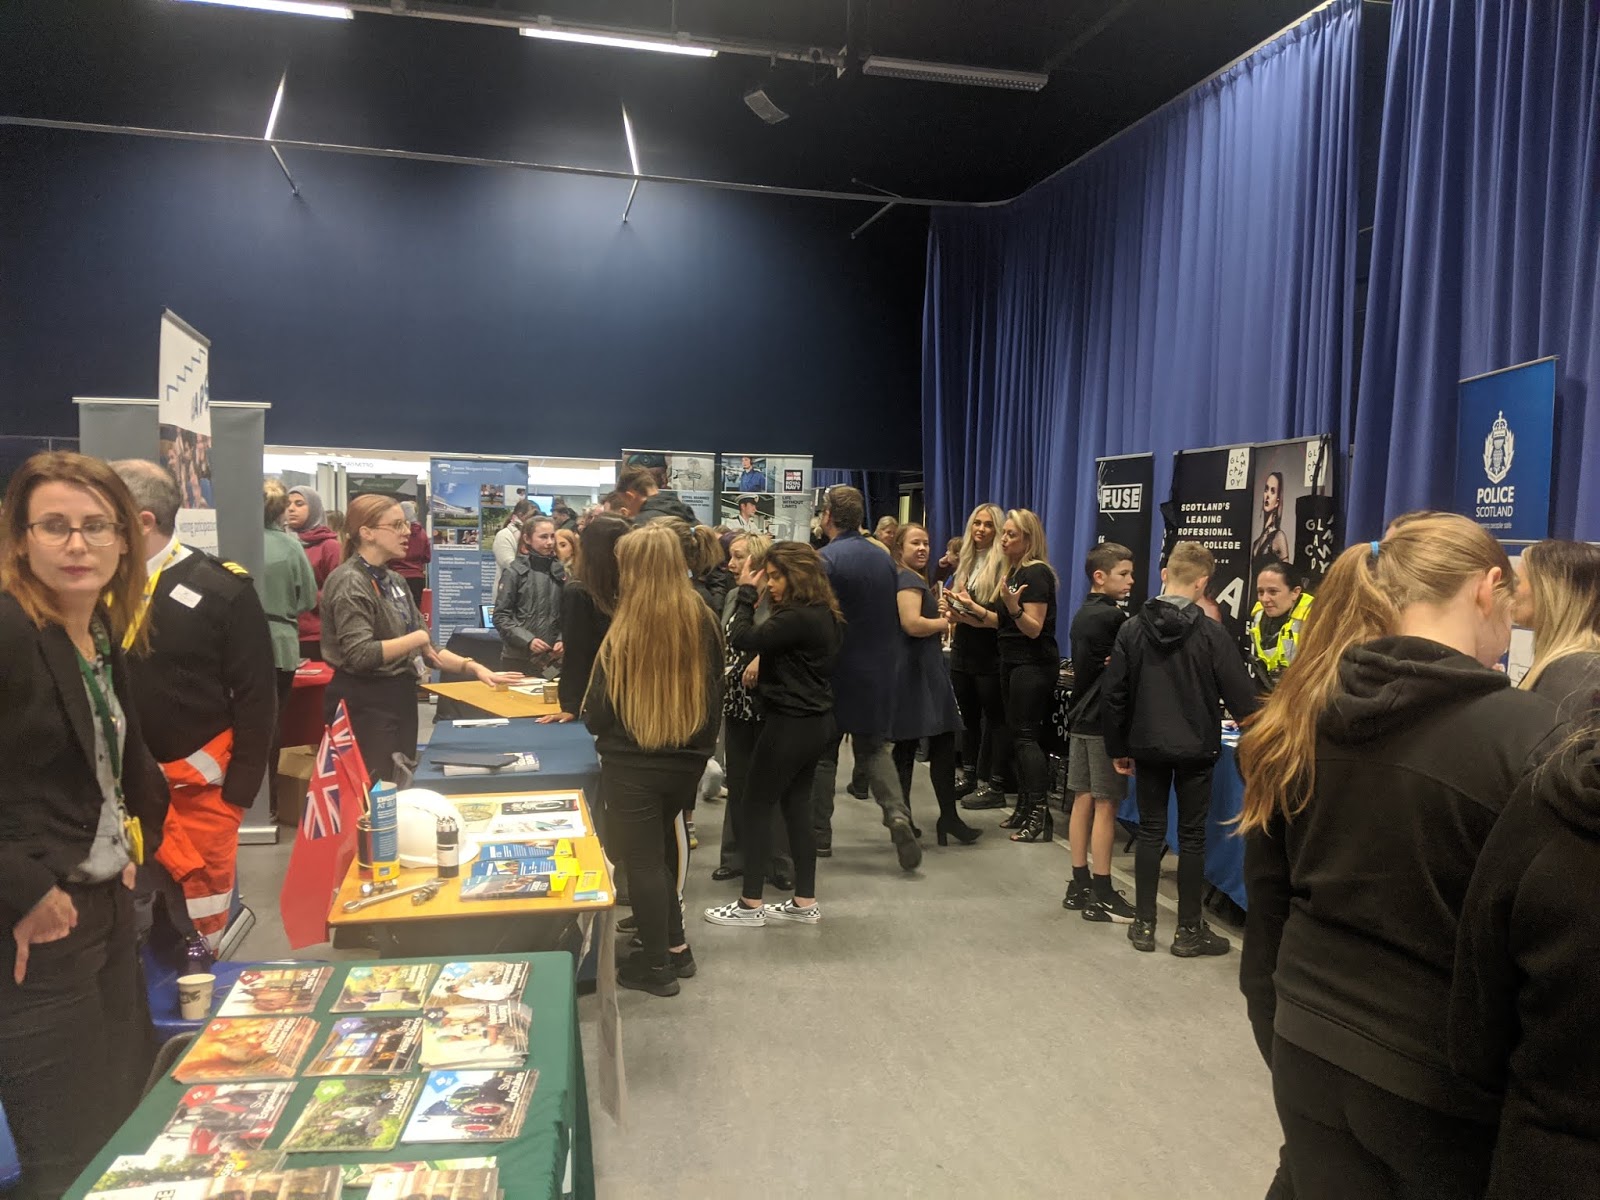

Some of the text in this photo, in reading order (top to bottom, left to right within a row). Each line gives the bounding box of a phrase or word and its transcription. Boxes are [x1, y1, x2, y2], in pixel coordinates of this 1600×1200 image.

[1102, 488, 1140, 509] FUSE
[1476, 486, 1515, 504] POLICE
[1180, 502, 1231, 512] SCOTLAND'S
[1475, 505, 1514, 518] SCOTLAND
[1185, 515, 1222, 524] LEADING
[1177, 527, 1233, 536] ROFESSIONAL
[1203, 541, 1241, 550] COLLEGE
[385, 1082, 404, 1099] Study
[498, 1074, 515, 1091] Study
[504, 1071, 525, 1102] Agriculture
[388, 1080, 413, 1115] Horticulture
